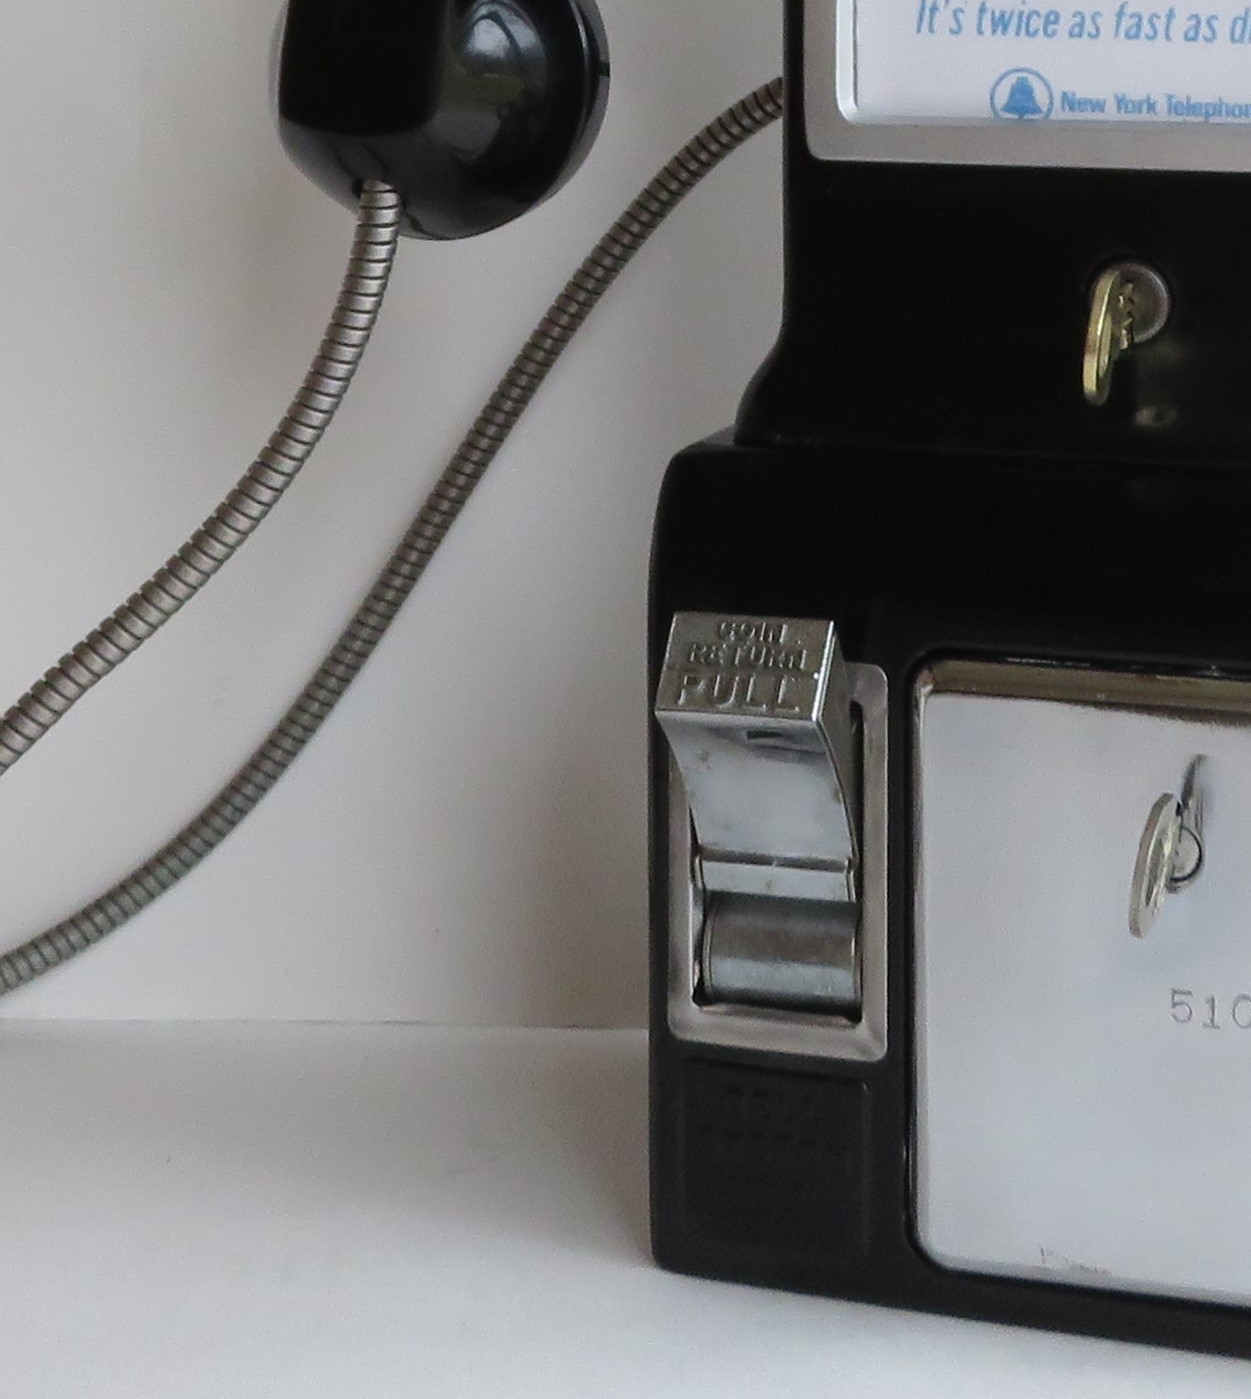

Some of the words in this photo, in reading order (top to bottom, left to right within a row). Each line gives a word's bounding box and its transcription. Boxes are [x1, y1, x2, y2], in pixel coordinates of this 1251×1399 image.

[975, 0, 1060, 38] twice
[1068, 10, 1102, 39] as
[1113, 1, 1176, 42] fast
[1183, 13, 1219, 43] as
[1060, 90, 1107, 113] New
[1114, 93, 1158, 115] York
[676, 672, 801, 713] PULL
